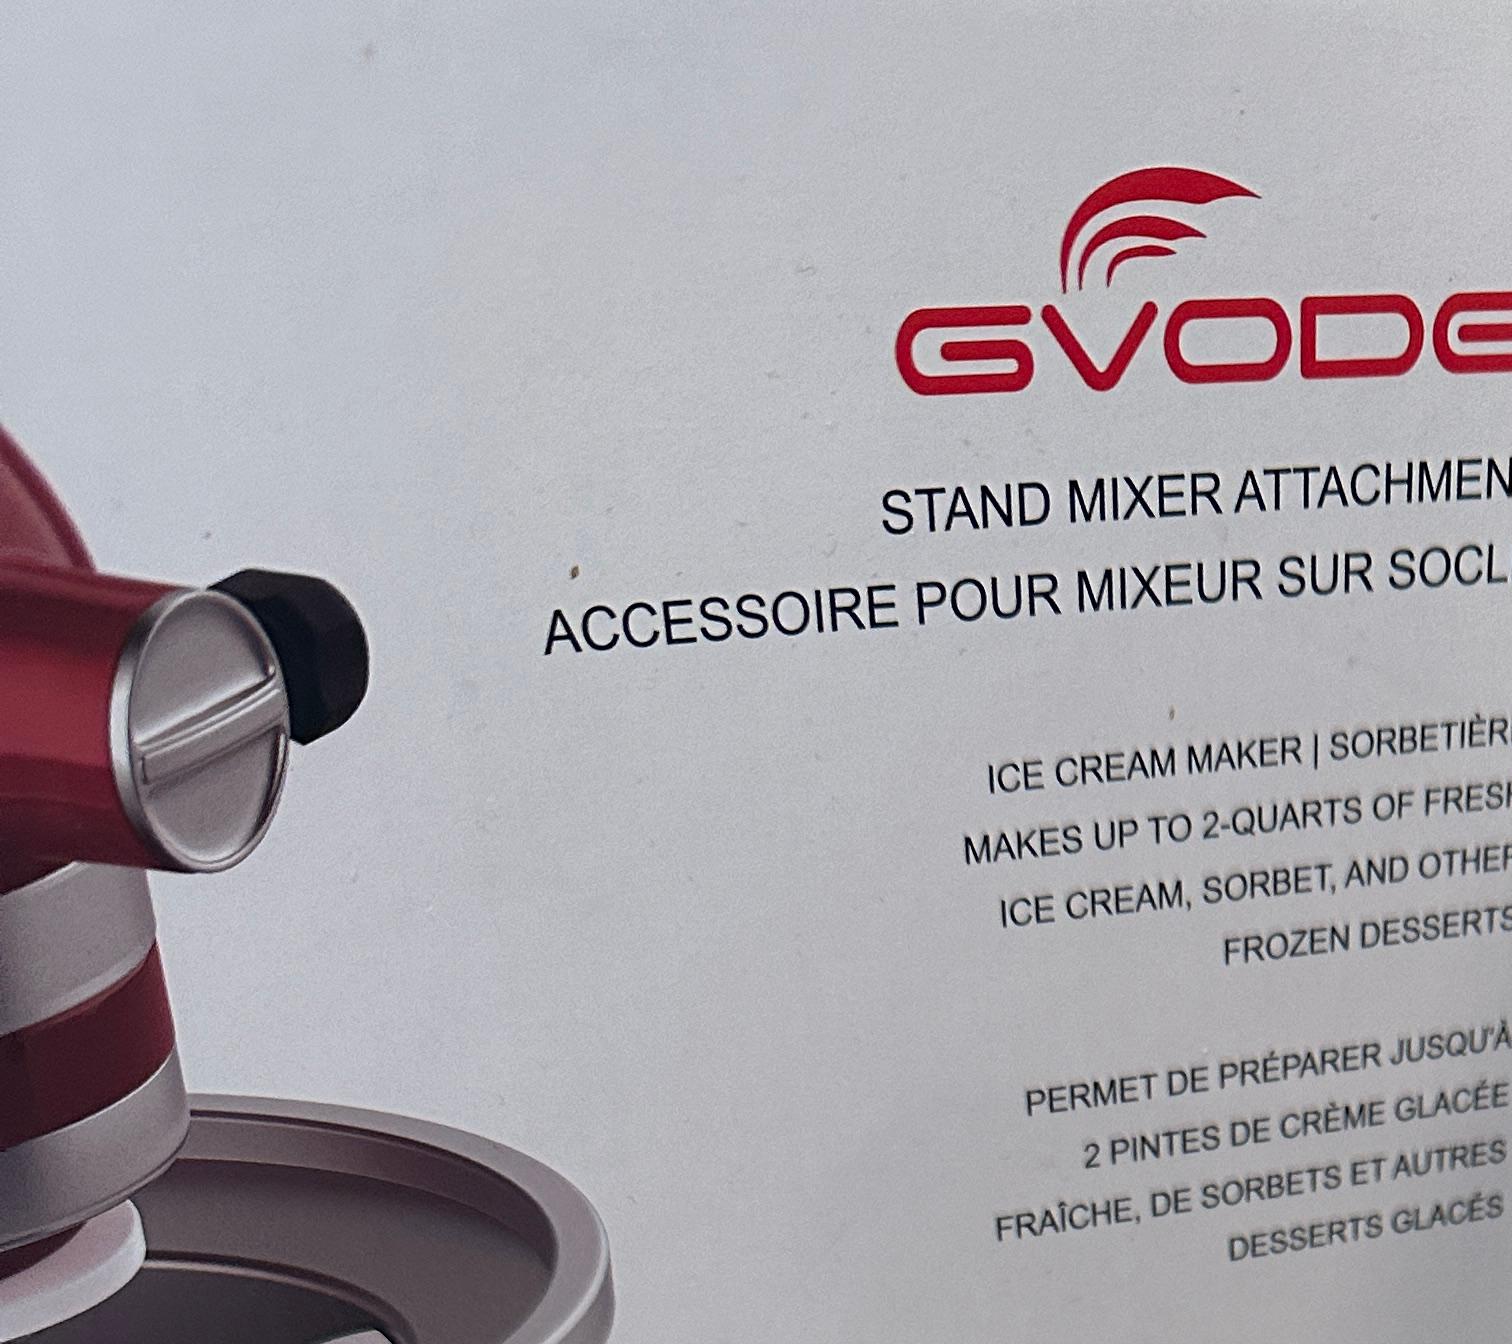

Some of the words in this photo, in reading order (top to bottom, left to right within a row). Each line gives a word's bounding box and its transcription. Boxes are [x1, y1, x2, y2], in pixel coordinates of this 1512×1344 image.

[881, 482, 1051, 535] STAND
[1069, 470, 1221, 524] MIXER
[544, 584, 899, 656] ACCESSOIRE
[916, 573, 1062, 625] POUR
[1077, 559, 1263, 613] MIXEUR
[1277, 551, 1373, 596] SUR
[987, 761, 1044, 793] ICE
[1055, 747, 1176, 788] CREAM
[1186, 736, 1303, 775] MAKER
[964, 824, 1082, 864] MAKES
[1094, 818, 1139, 850] UP
[1147, 814, 1193, 844] TO
[1202, 796, 1362, 839] 2-QUARTS
[1372, 792, 1413, 819] OF
[1000, 896, 1055, 927] ICE
[1066, 880, 1193, 921] CREAM,
[1202, 863, 1337, 904] SORBET,
[1343, 854, 1409, 887] AND
[1224, 925, 1350, 965] FROZEN
[1026, 1072, 1158, 1116] PERMET
[1167, 1066, 1210, 1096] DE
[1218, 1042, 1381, 1089] PRÉPARER
[1389, 1018, 1512, 1066] JUSQU'À
[1083, 1142, 1101, 1169] 2
[1110, 1125, 1221, 1165] PINTES
[1230, 1120, 1271, 1147] DE
[1280, 1098, 1385, 1140] CRÈME
[1394, 1081, 1510, 1123] GLACÉE
[995, 1196, 1142, 1241] FRAÎCHE,
[1150, 1188, 1192, 1218] DE
[1201, 1165, 1342, 1209] SORBETS
[1350, 1157, 1385, 1184] ET
[1392, 1139, 1507, 1181] AUTRES
[1228, 1213, 1384, 1261] DESSERTS
[1390, 1192, 1505, 1234] GLACÉS
